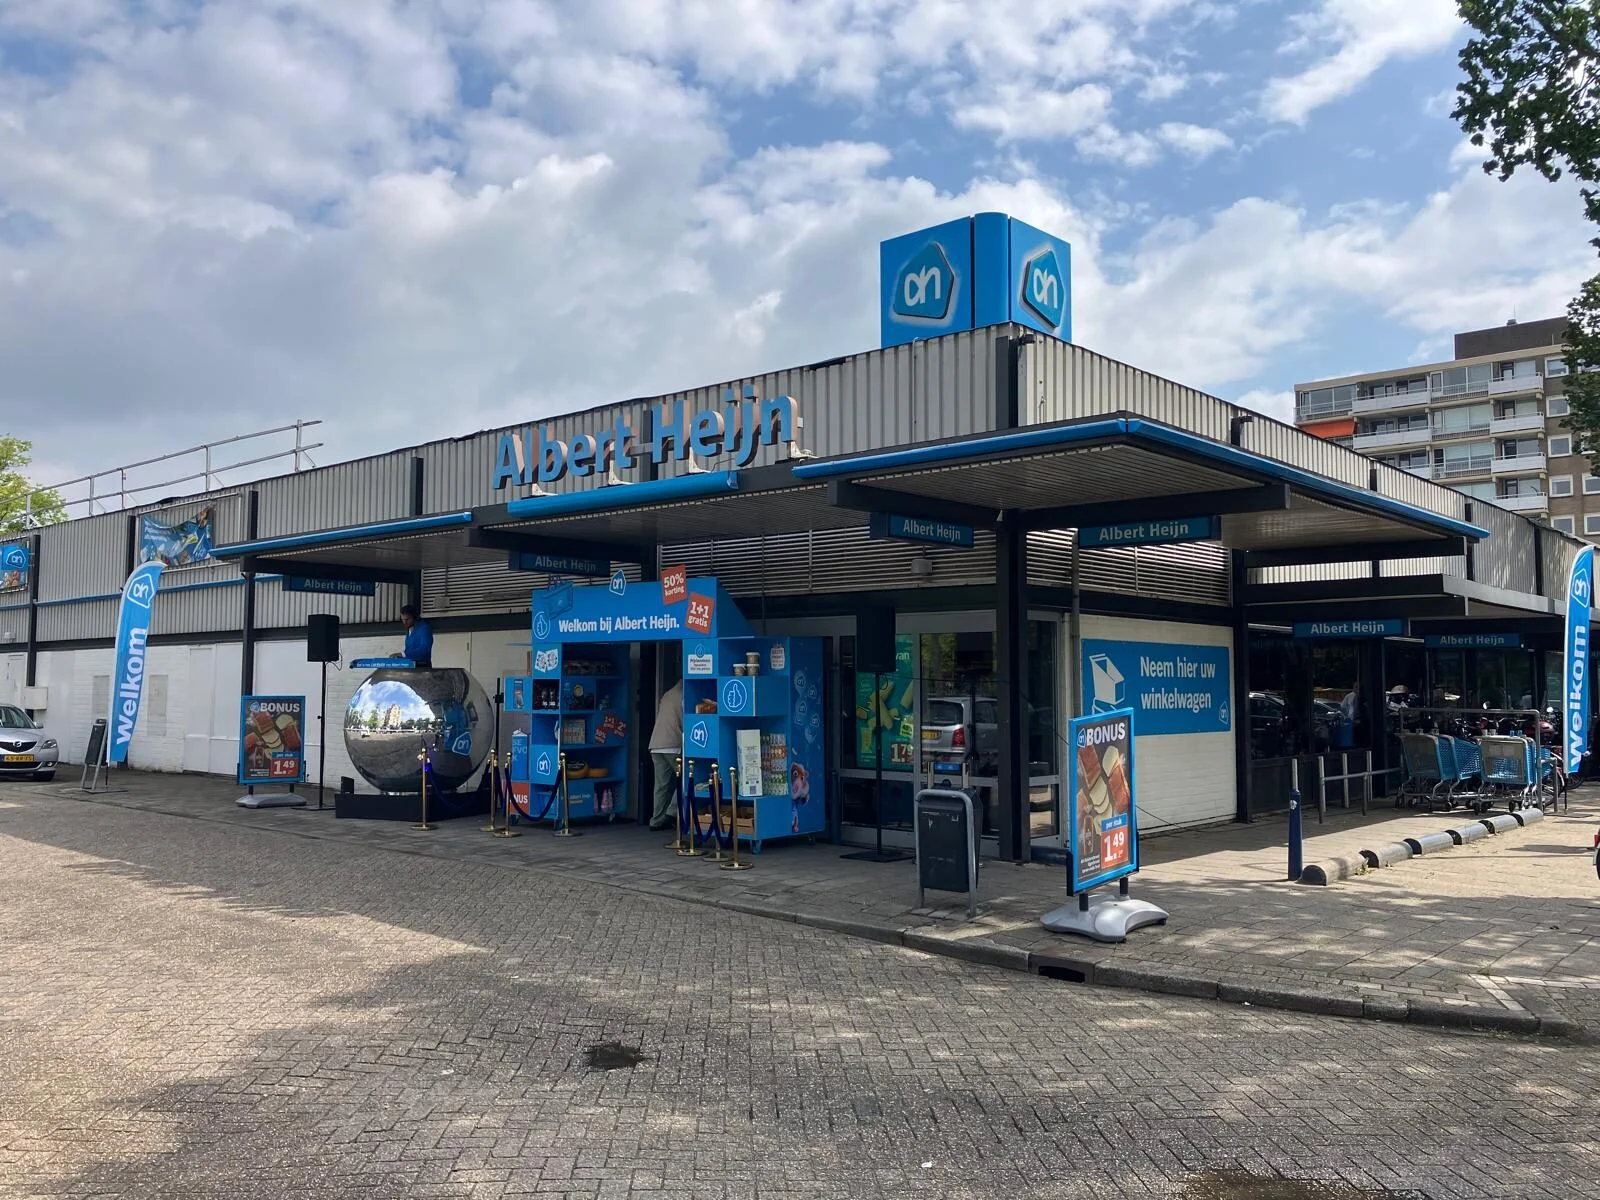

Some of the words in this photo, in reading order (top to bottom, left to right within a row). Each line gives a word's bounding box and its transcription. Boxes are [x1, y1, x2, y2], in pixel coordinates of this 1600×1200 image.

[492, 414, 638, 490] Albert
[651, 383, 798, 468] Heijn
[903, 519, 934, 537] Albert
[936, 523, 961, 542] Heijn
[1099, 525, 1145, 542] Albert
[1149, 521, 1189, 538] Heijn
[534, 555, 567, 569] Albert
[570, 559, 597, 573] Heijn
[303, 579, 335, 590] Albert
[337, 581, 362, 593] Heijn
[663, 572, 684, 588] 50%
[664, 585, 685, 597] korting
[690, 601, 709, 618] 1+1
[558, 618, 597, 633] Welkom
[600, 616, 612, 634] bij
[614, 615, 647, 631] Albert
[649, 613, 680, 631] Heijn.
[687, 614, 708, 628] gratis
[1310, 622, 1348, 634] Albert
[1352, 621, 1385, 634] Heijn
[1439, 634, 1473, 645] Albert
[1476, 633, 1505, 646] Heijn
[1140, 656, 1174, 678] Neem
[1177, 656, 1198, 678] hier
[1200, 662, 1216, 679] uw
[260, 702, 300, 713] BONUS
[1140, 687, 1212, 714] winkelwagen
[1086, 722, 1126, 746] BONUS
